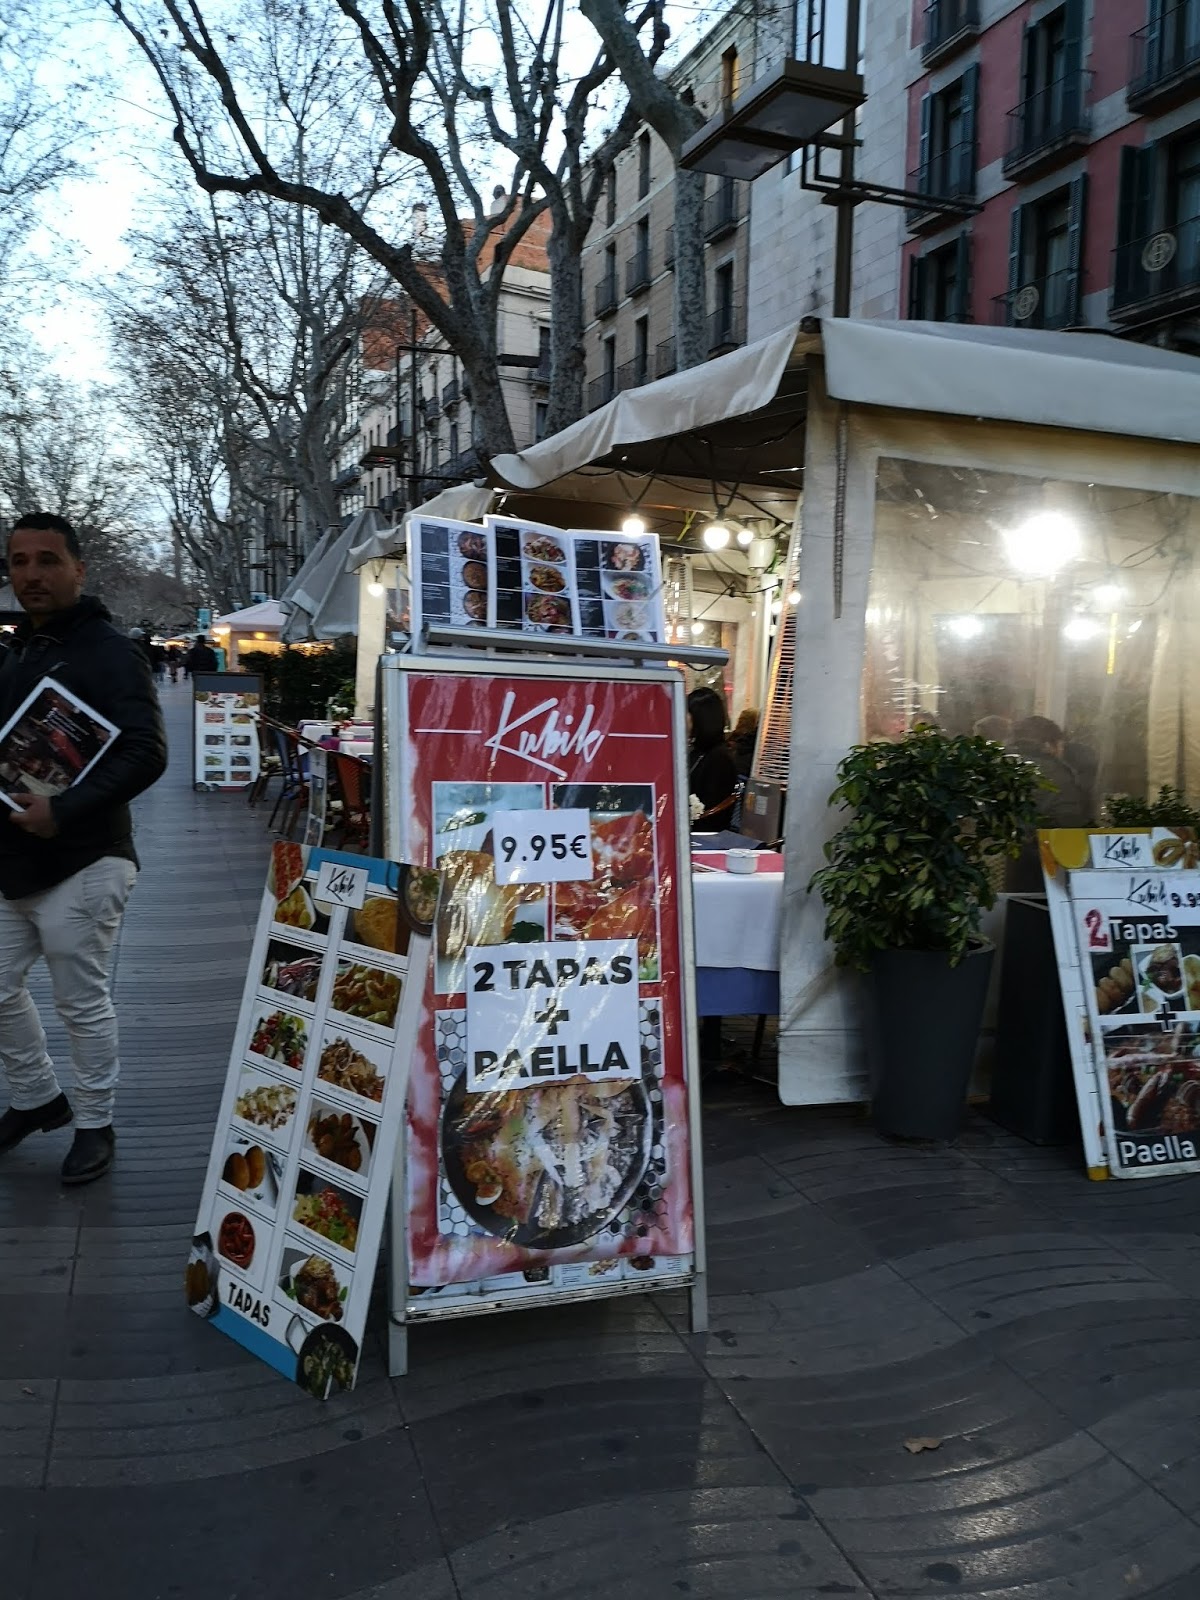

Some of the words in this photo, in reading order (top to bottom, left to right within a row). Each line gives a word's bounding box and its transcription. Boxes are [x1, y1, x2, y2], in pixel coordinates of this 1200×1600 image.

[484, 691, 605, 778] Kubik
[501, 833, 588, 863] 9.95€
[1084, 909, 1108, 948] 2
[1109, 919, 1178, 945] Tapas
[473, 961, 495, 992] 2
[503, 956, 633, 991] TAPAS
[474, 1041, 629, 1079] PAELLA
[1119, 1135, 1197, 1165] Paella
[227, 1282, 271, 1327] TAPAS
